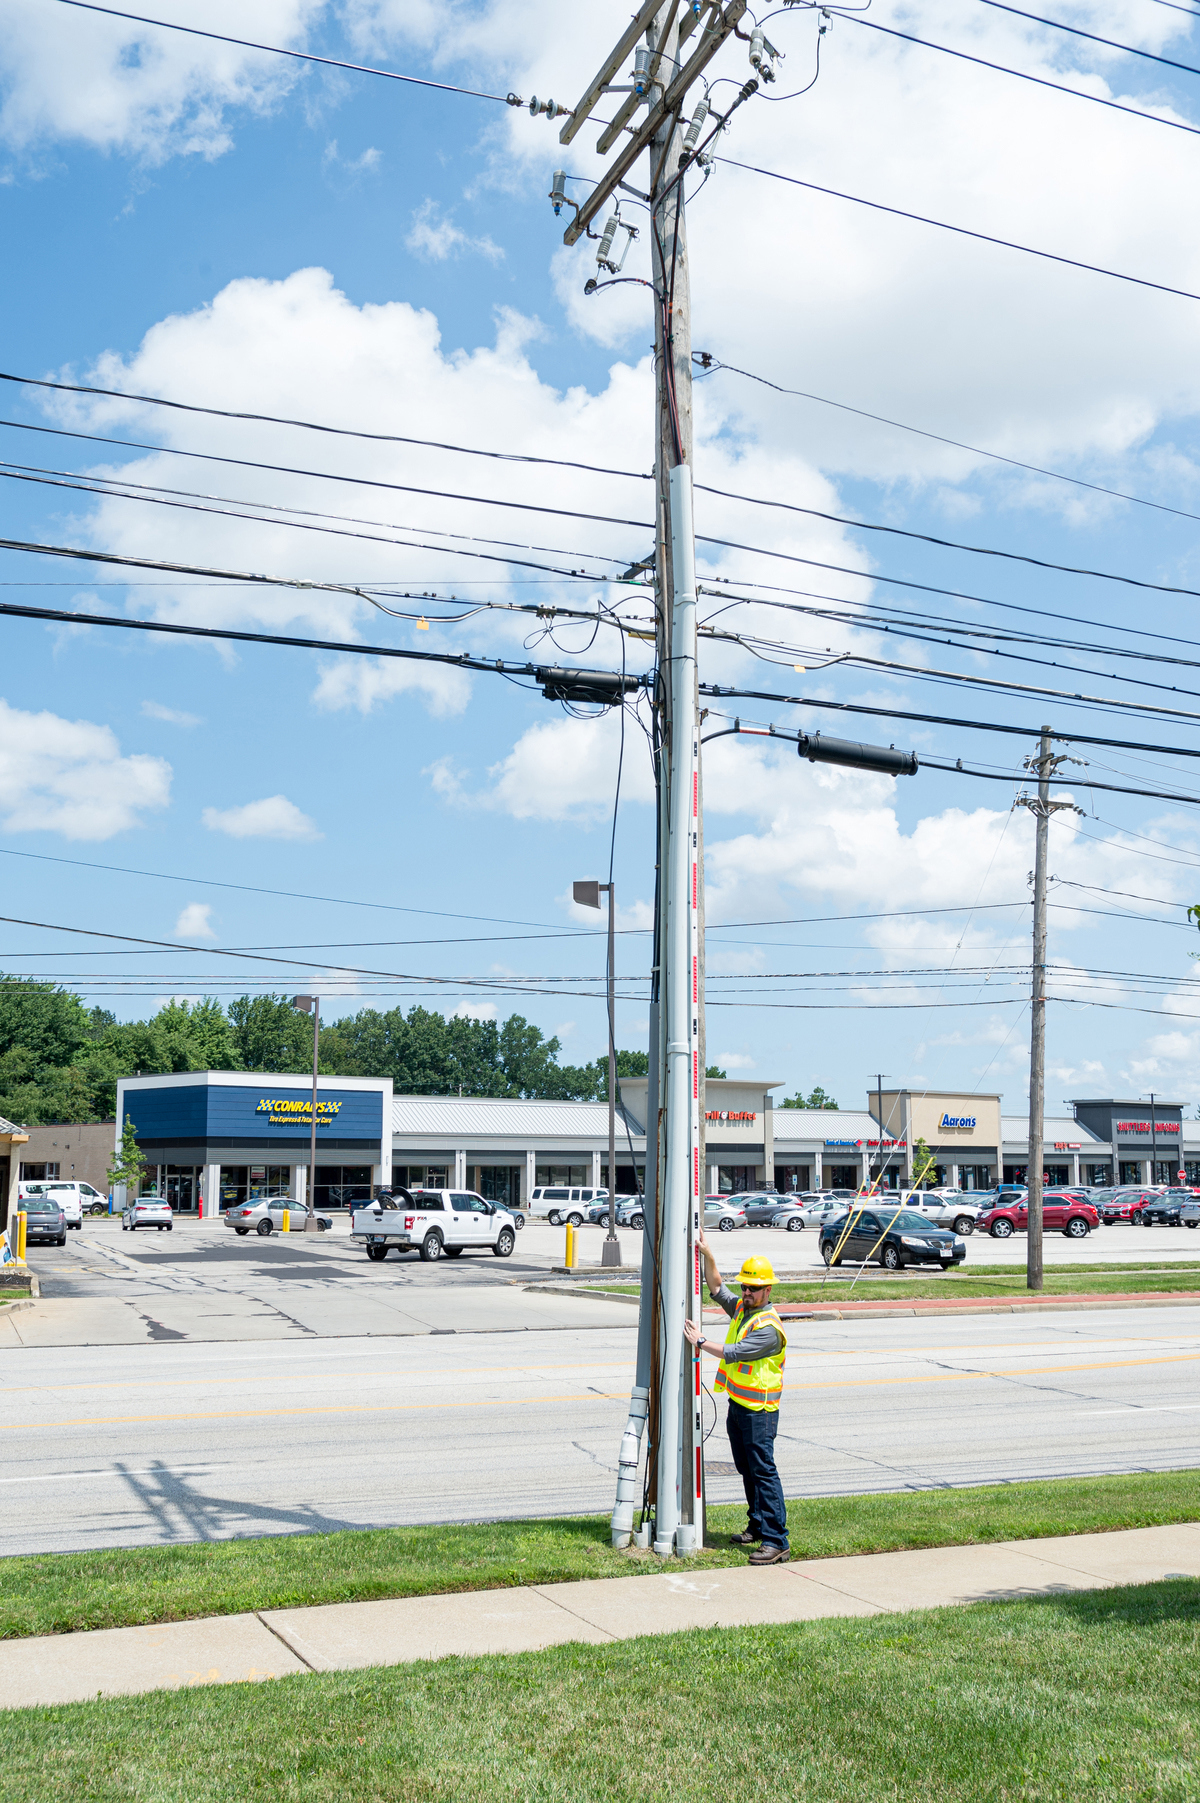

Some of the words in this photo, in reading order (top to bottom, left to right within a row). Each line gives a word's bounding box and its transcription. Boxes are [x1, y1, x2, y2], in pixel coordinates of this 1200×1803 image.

[274, 1101, 326, 1113] CONRAD'S
[728, 1111, 756, 1121] Buffet
[941, 1113, 976, 1128] Aaron's
